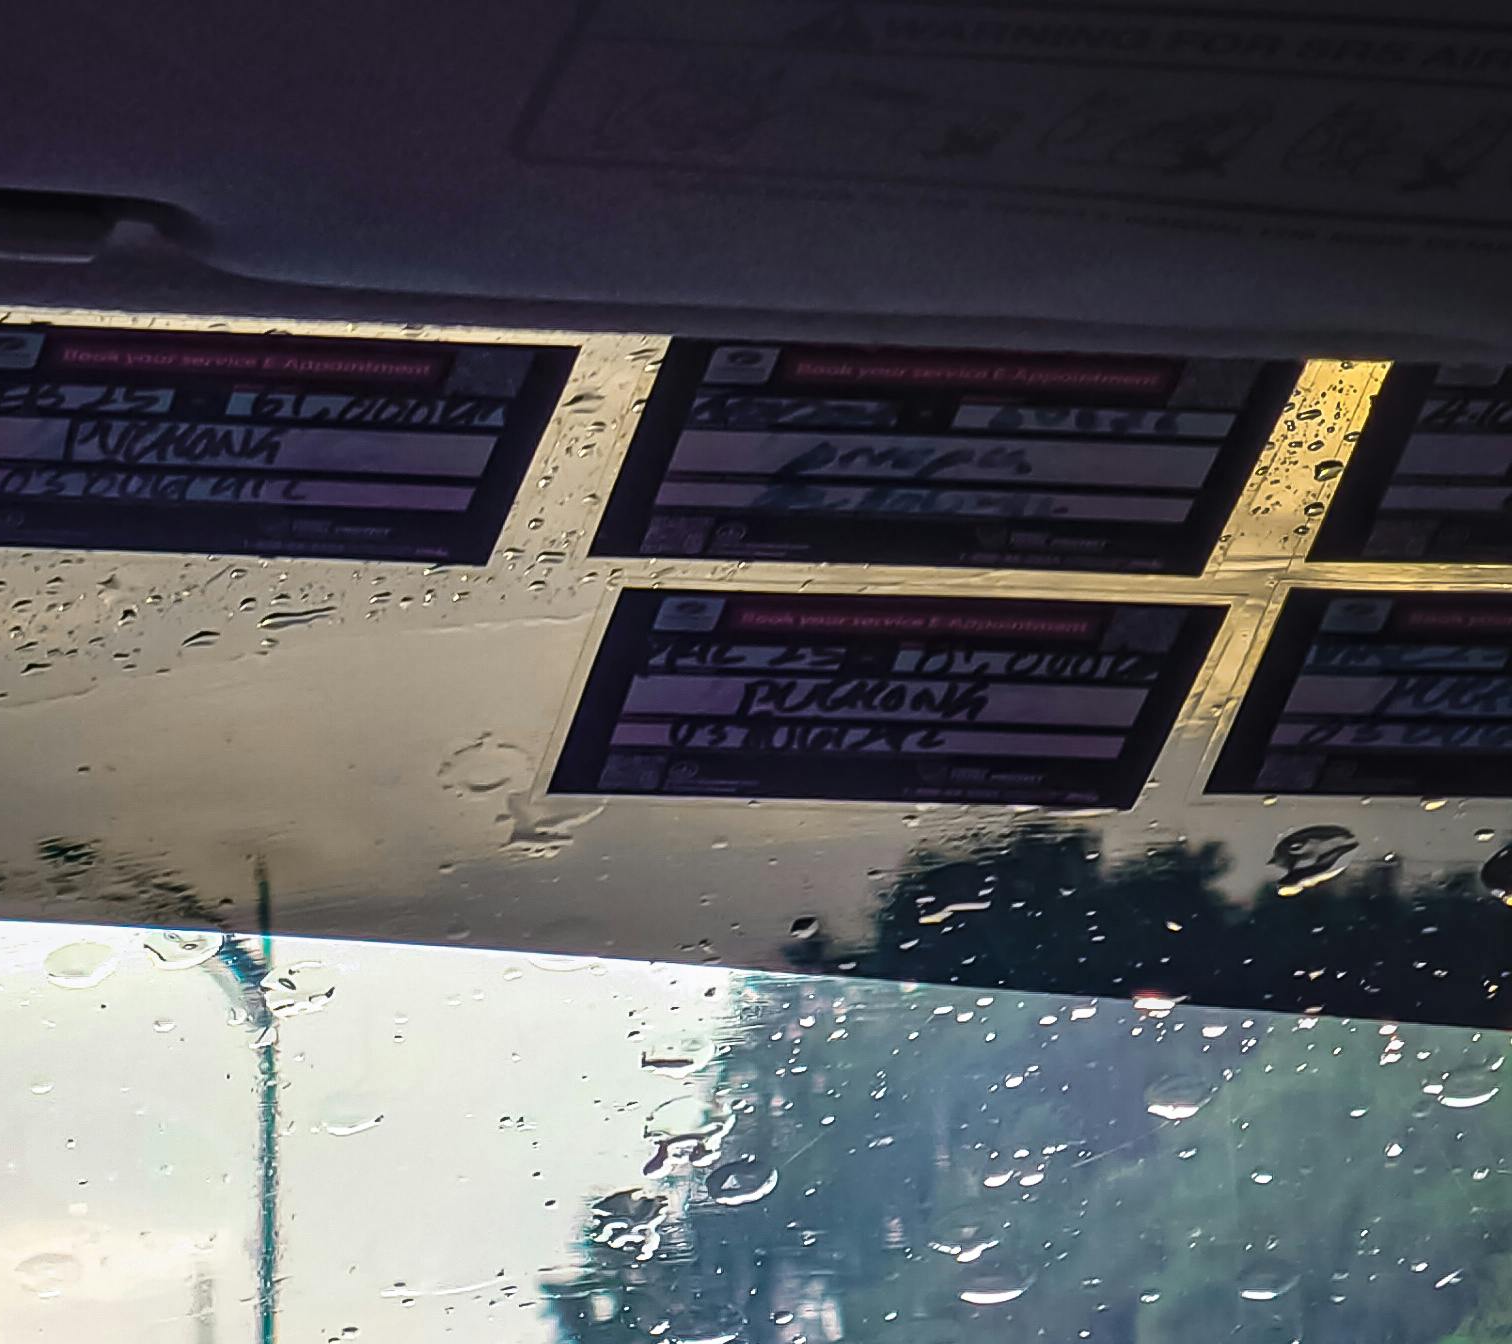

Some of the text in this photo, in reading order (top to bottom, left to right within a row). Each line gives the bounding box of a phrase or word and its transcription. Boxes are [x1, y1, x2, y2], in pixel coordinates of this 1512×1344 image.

[883, 15, 1153, 52] WARNING
[1168, 29, 1284, 58] FOR
[1296, 36, 1410, 66] SRS
[63, 347, 119, 363] Book
[125, 350, 176, 367] your
[181, 354, 257, 369] service
[795, 361, 853, 377] Book
[855, 365, 907, 380] your
[911, 366, 989, 381] service
[740, 611, 794, 626] Book
[798, 614, 848, 629] your
[852, 615, 923, 629] service
